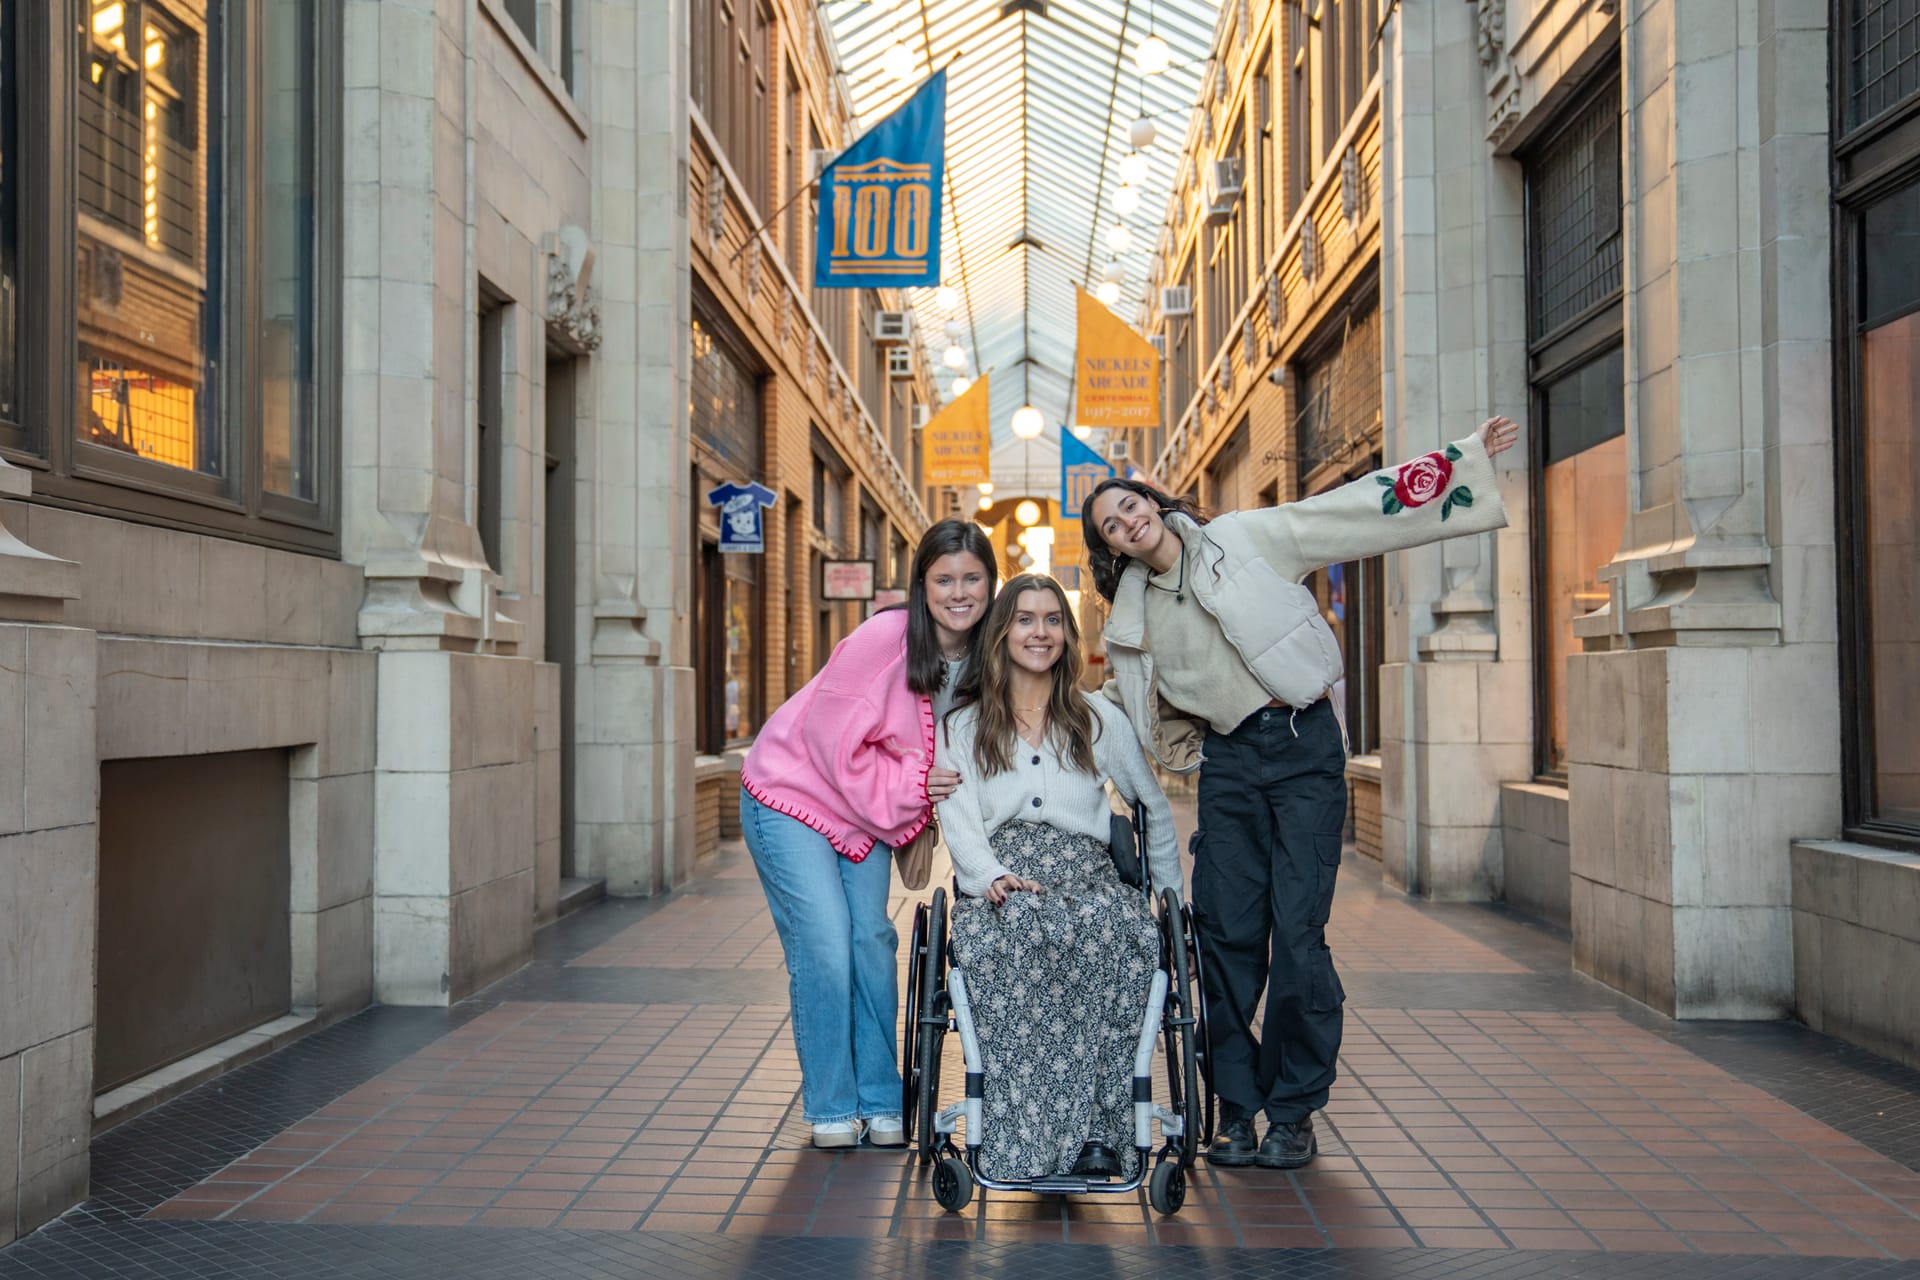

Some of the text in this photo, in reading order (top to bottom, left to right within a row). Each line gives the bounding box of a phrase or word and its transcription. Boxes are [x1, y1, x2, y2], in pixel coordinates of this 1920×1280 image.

[831, 184, 931, 258] 100
[1086, 358, 1151, 371] NICKELS
[1086, 375, 1148, 389] ARCADE
